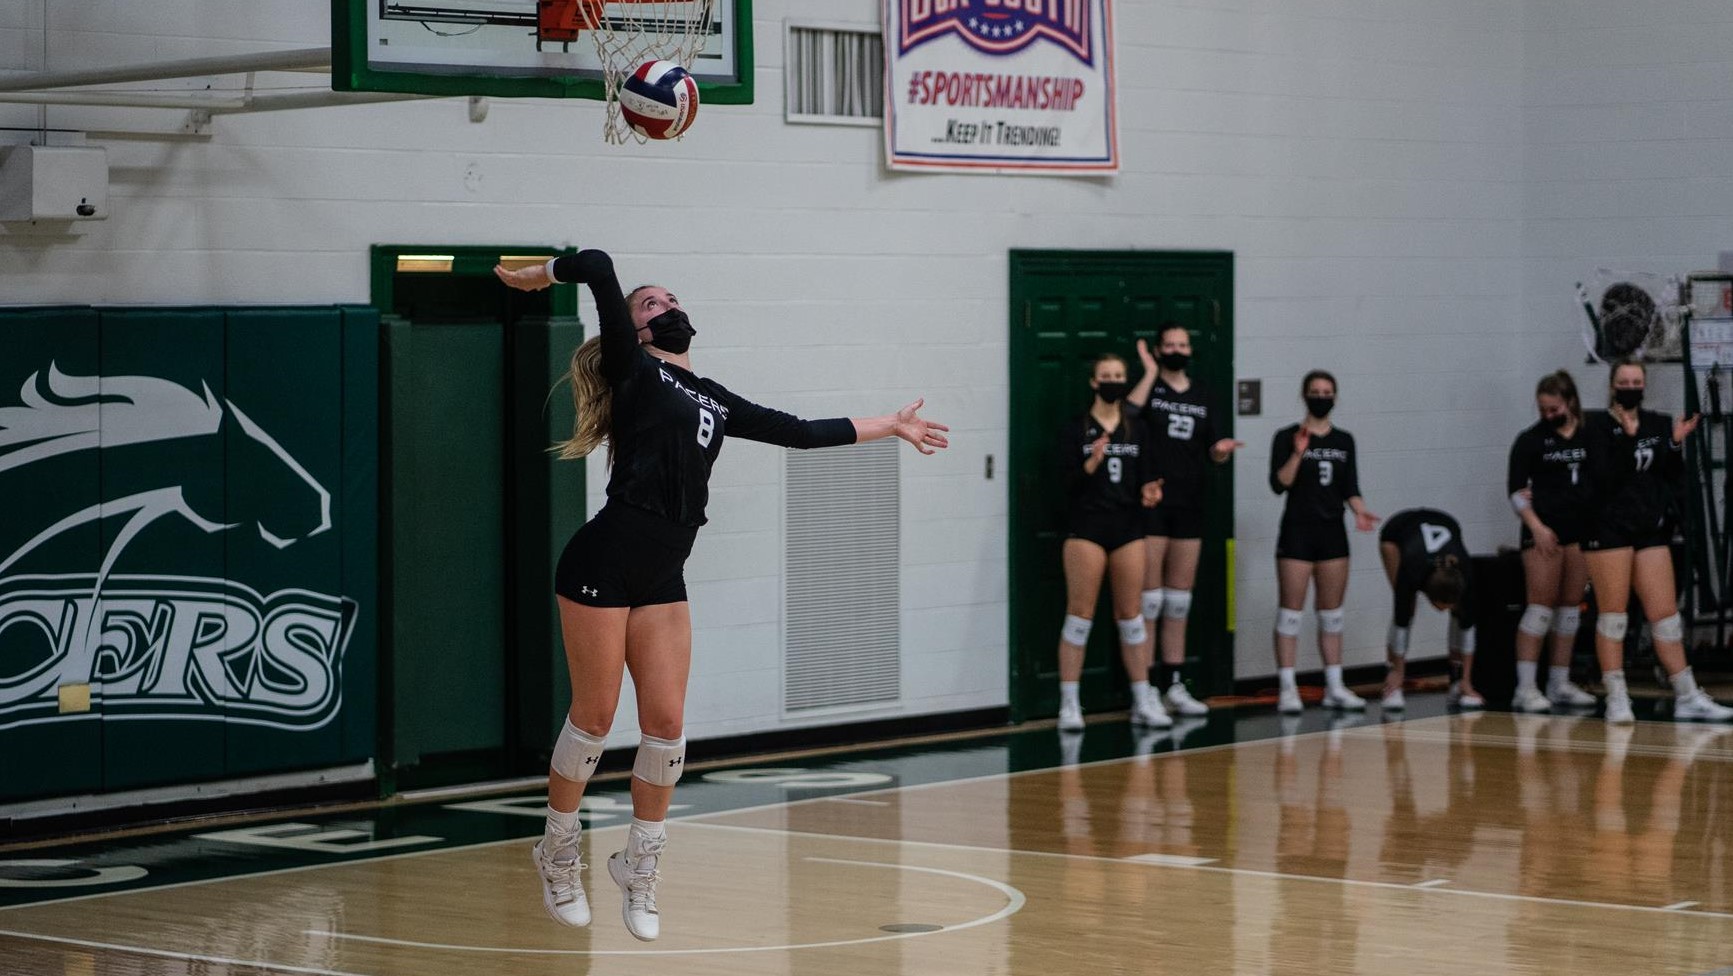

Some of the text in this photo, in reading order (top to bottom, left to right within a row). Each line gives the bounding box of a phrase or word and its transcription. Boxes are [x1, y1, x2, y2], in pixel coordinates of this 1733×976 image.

[908, 71, 1085, 111] #SPORTSMANSHIP
[1151, 399, 1207, 418] PACERS
[696, 407, 715, 449] 8
[1167, 413, 1195, 441] 23
[1083, 443, 1139, 456] PCERS
[1302, 448, 1347, 462] ACERS
[1543, 448, 1587, 461] PACE
[1634, 448, 1654, 472] 17
[1107, 457, 1122, 483] 9
[1318, 461, 1333, 486] 3
